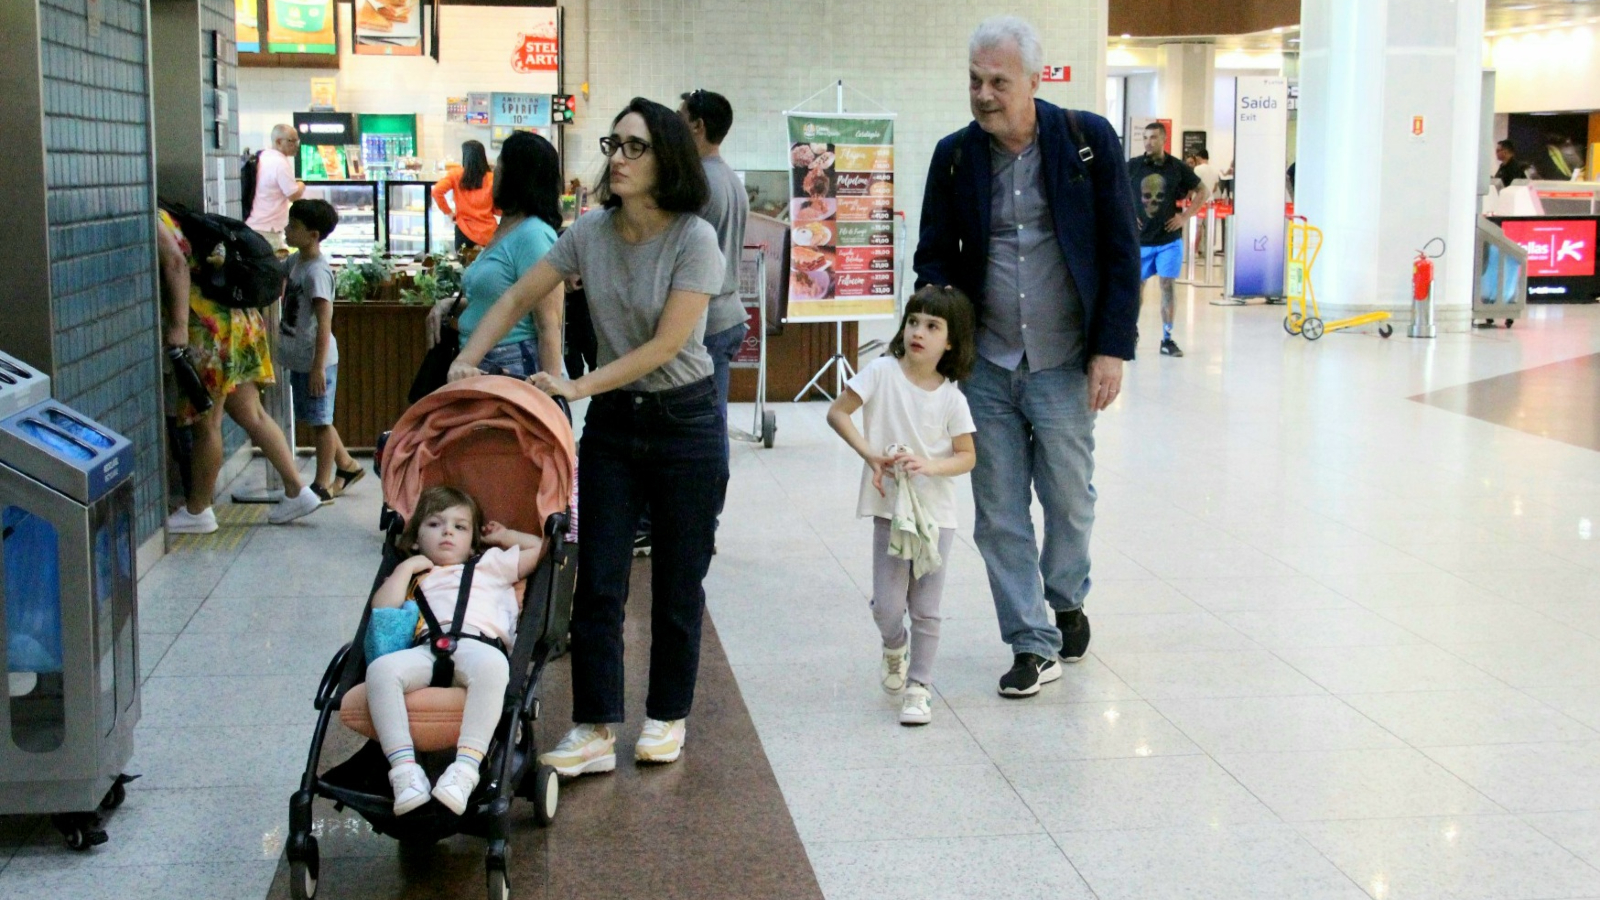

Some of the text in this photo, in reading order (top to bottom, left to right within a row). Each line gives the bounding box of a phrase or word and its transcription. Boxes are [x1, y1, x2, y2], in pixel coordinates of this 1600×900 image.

[526, 42, 558, 53] STEL
[525, 54, 558, 65] ART
[1241, 96, 1277, 109] Saída
[502, 103, 539, 114] SPIRIT
[1240, 113, 1257, 121] Exit
